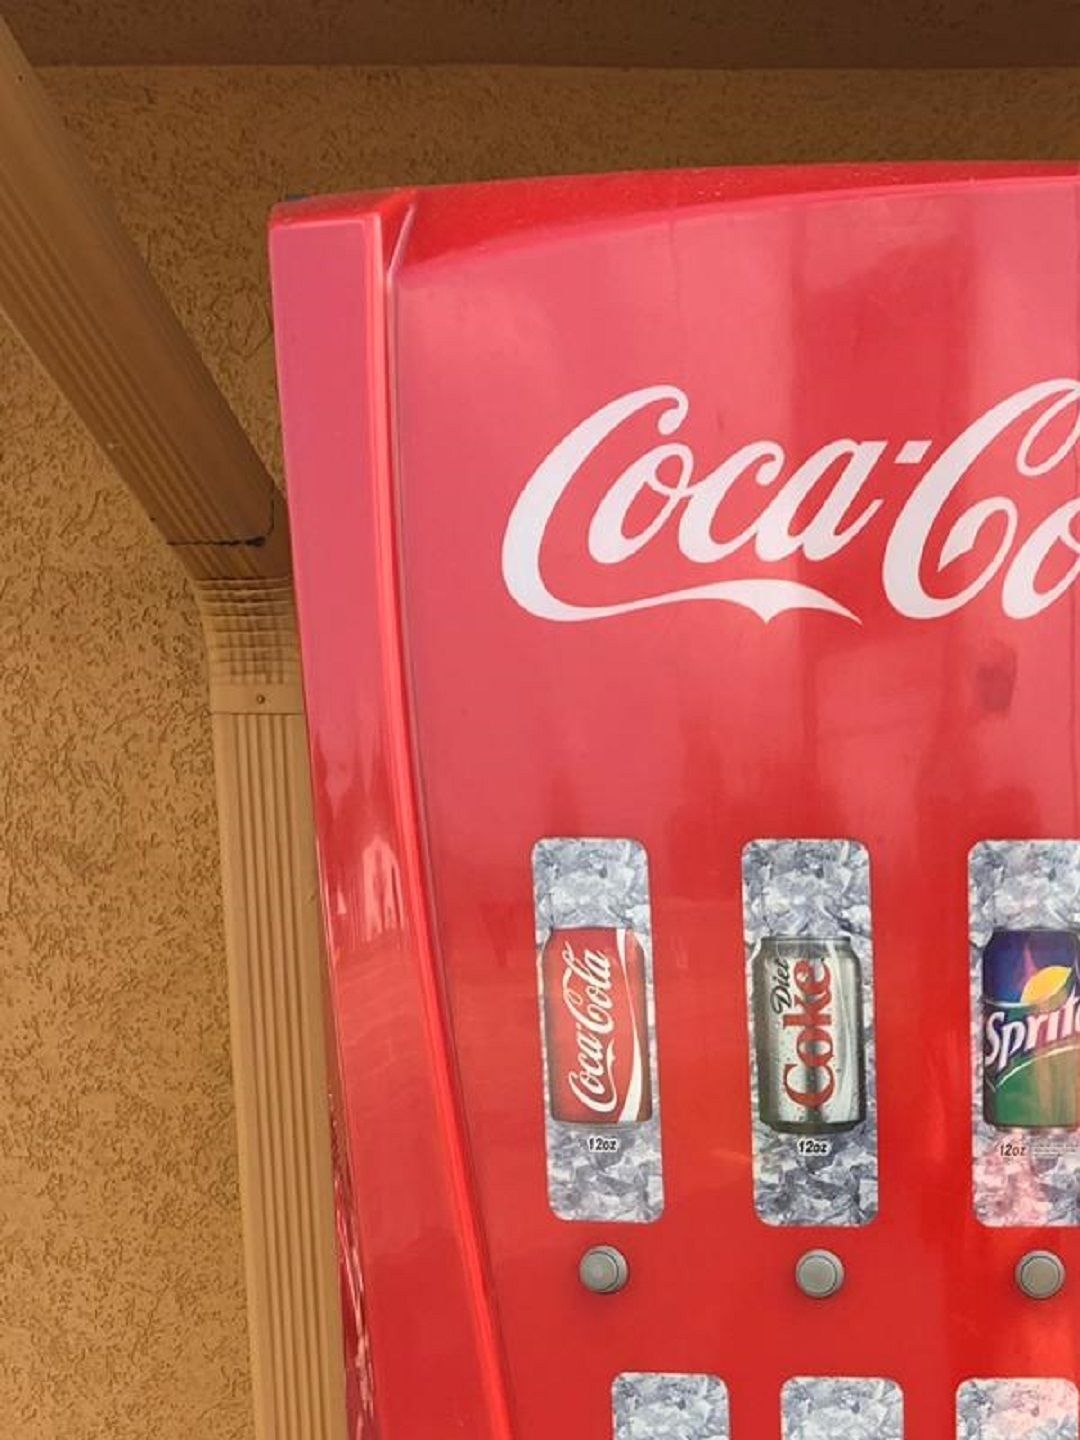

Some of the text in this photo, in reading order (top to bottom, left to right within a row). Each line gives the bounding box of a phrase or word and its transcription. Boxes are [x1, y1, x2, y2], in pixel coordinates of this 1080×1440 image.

[561, 940, 618, 1113] Coca-Cola
[770, 958, 793, 1015] Diet
[782, 959, 836, 1110] Coke
